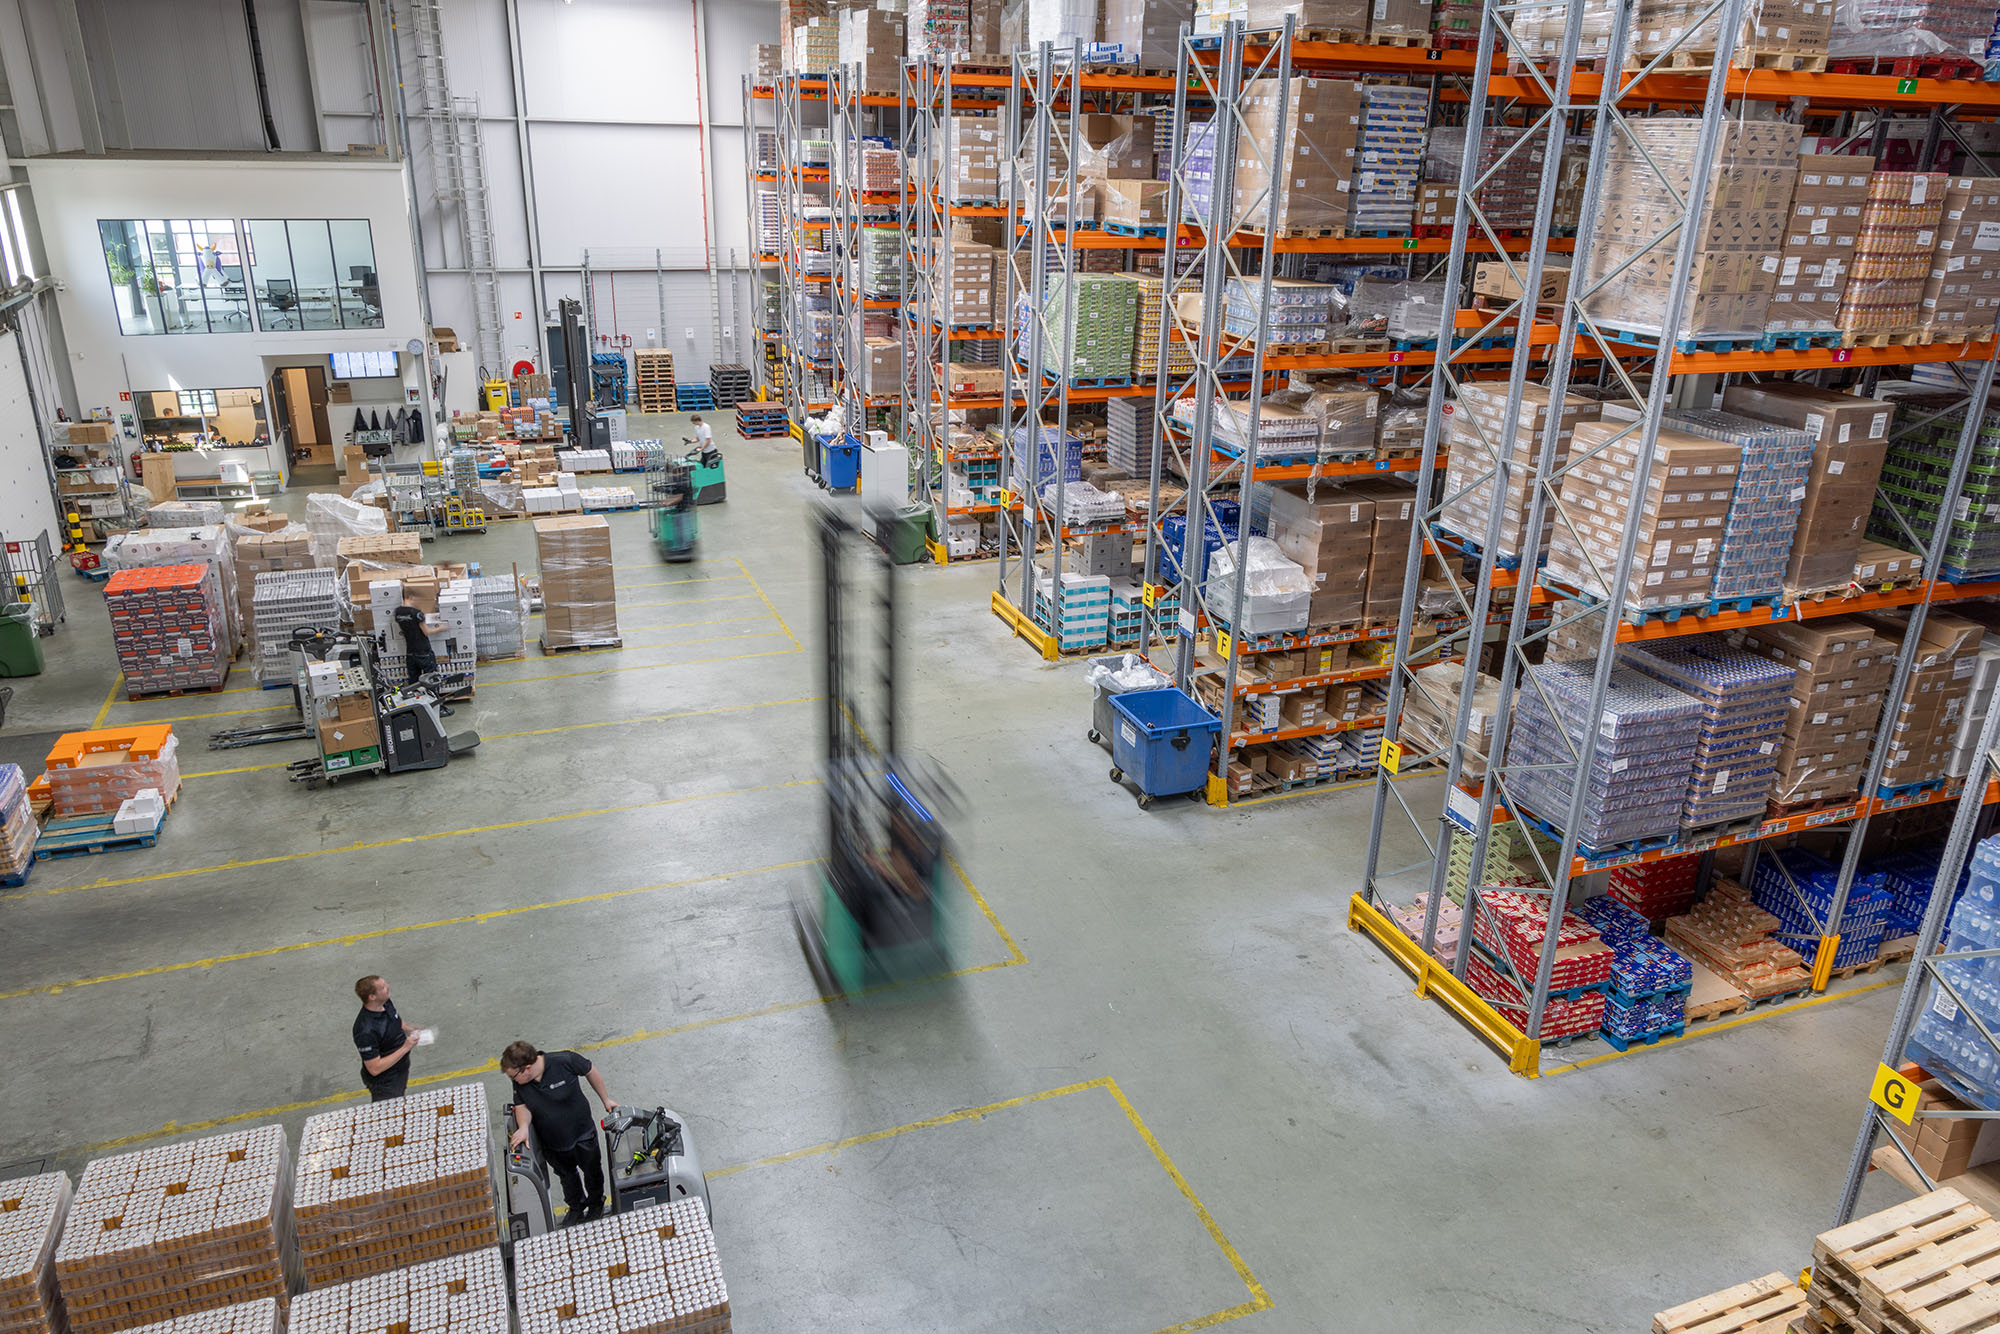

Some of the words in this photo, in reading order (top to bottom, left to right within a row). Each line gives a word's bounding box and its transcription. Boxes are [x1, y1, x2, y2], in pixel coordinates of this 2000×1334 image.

[1431, 50, 1438, 60] 8
[1192, 79, 1198, 87] 7
[1903, 80, 1911, 94] 7
[1181, 238, 1186, 246] 6
[1407, 239, 1414, 249] 7
[1393, 353, 1399, 362] 6
[1838, 350, 1846, 361] 6
[1380, 461, 1385, 469] 5
[1003, 492, 1007, 504] D
[1146, 587, 1151, 602] E
[1777, 607, 1784, 618] 5
[1221, 636, 1227, 652] F
[1385, 745, 1394, 763] F
[1884, 1079, 1906, 1109] G
